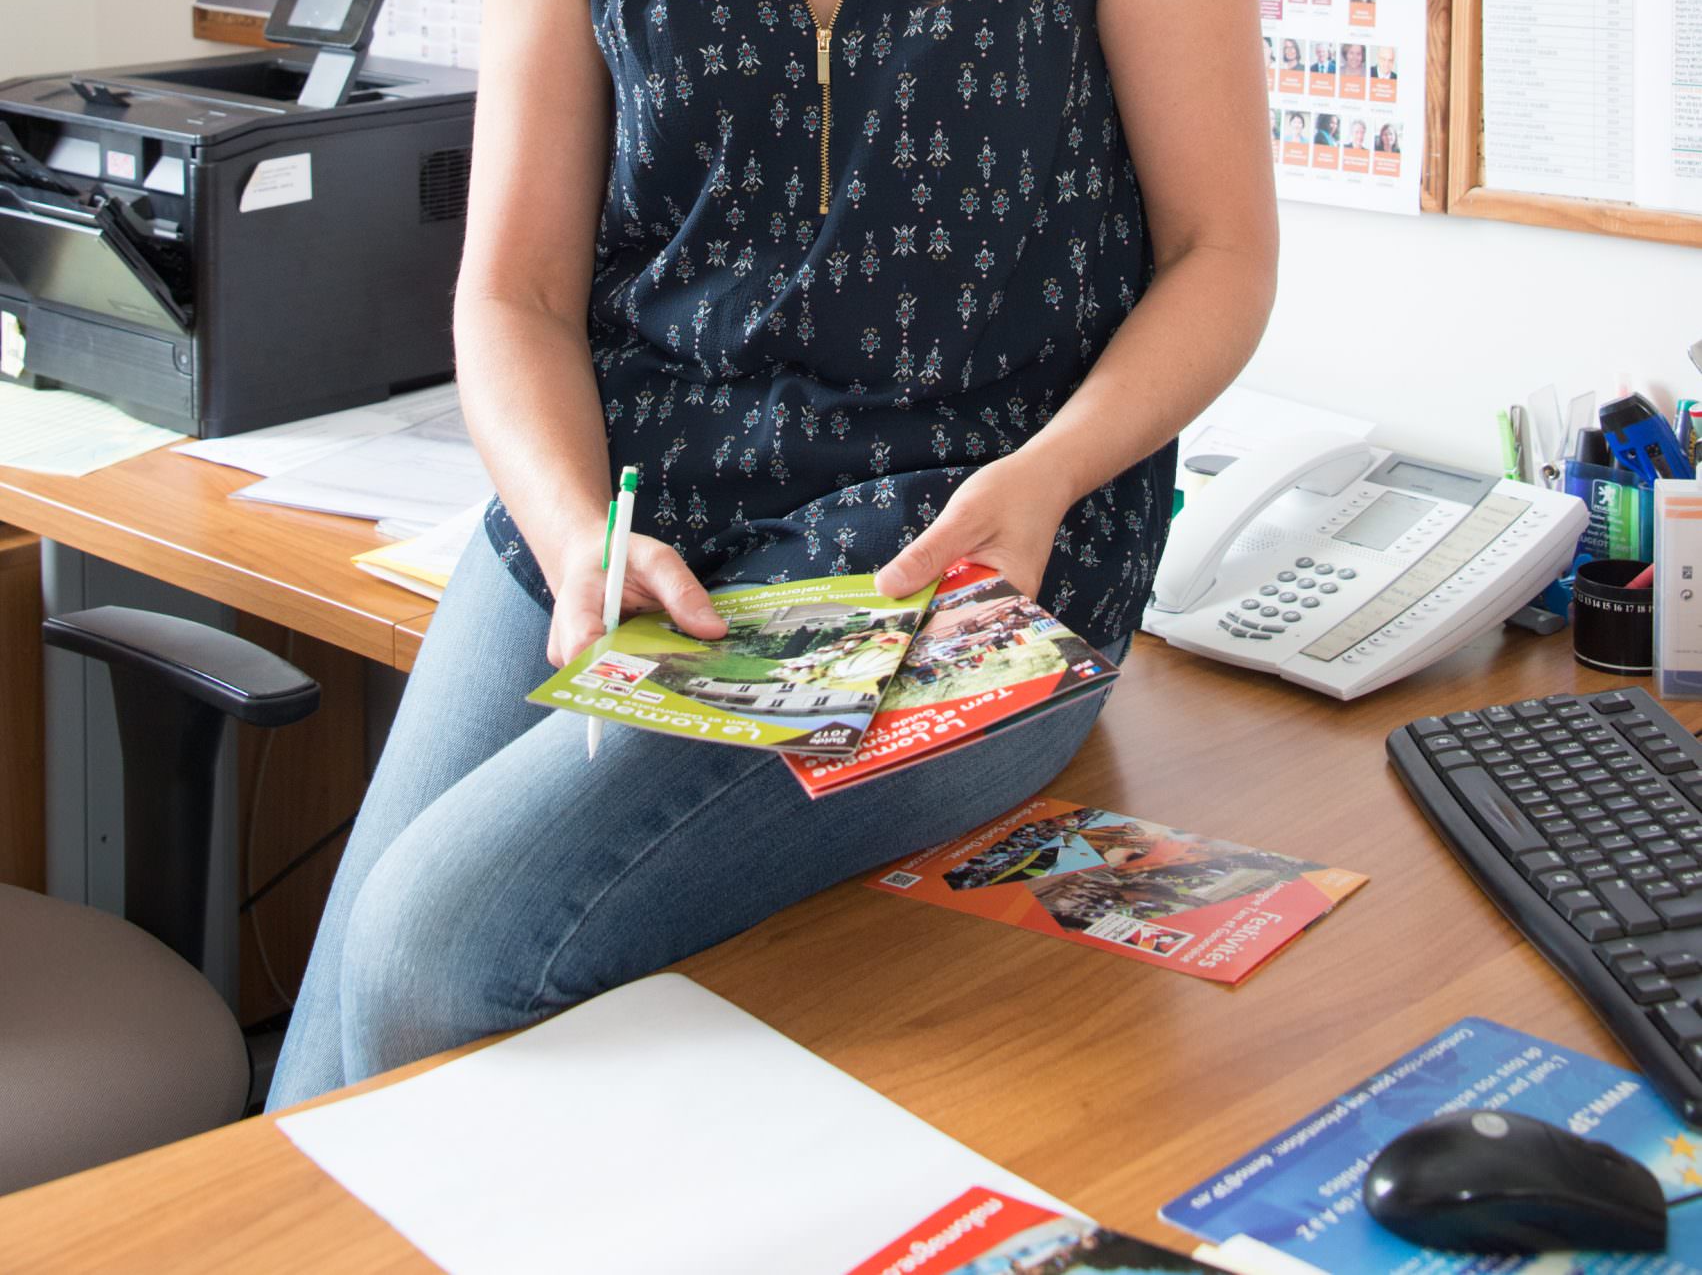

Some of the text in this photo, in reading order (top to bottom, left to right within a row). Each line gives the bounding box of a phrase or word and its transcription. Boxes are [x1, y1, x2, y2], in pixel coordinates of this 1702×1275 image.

[551, 689, 763, 741] La Lomagne
[932, 686, 1014, 724] Tarn et
[726, 717, 757, 727] Tarn
[891, 708, 938, 729] Guide
[808, 735, 849, 746] Guide
[812, 727, 853, 740] 2017
[811, 716, 968, 778] La Lomagne
[1197, 911, 1283, 969] Festivités
[1473, 1046, 1543, 1093] de tous vos
[1506, 1054, 1569, 1098] L'outil par
[1368, 1074, 1397, 1096] pour
[1344, 1091, 1371, 1110] une
[1332, 1195, 1356, 1214] de
[1295, 1224, 1318, 1242] Z
